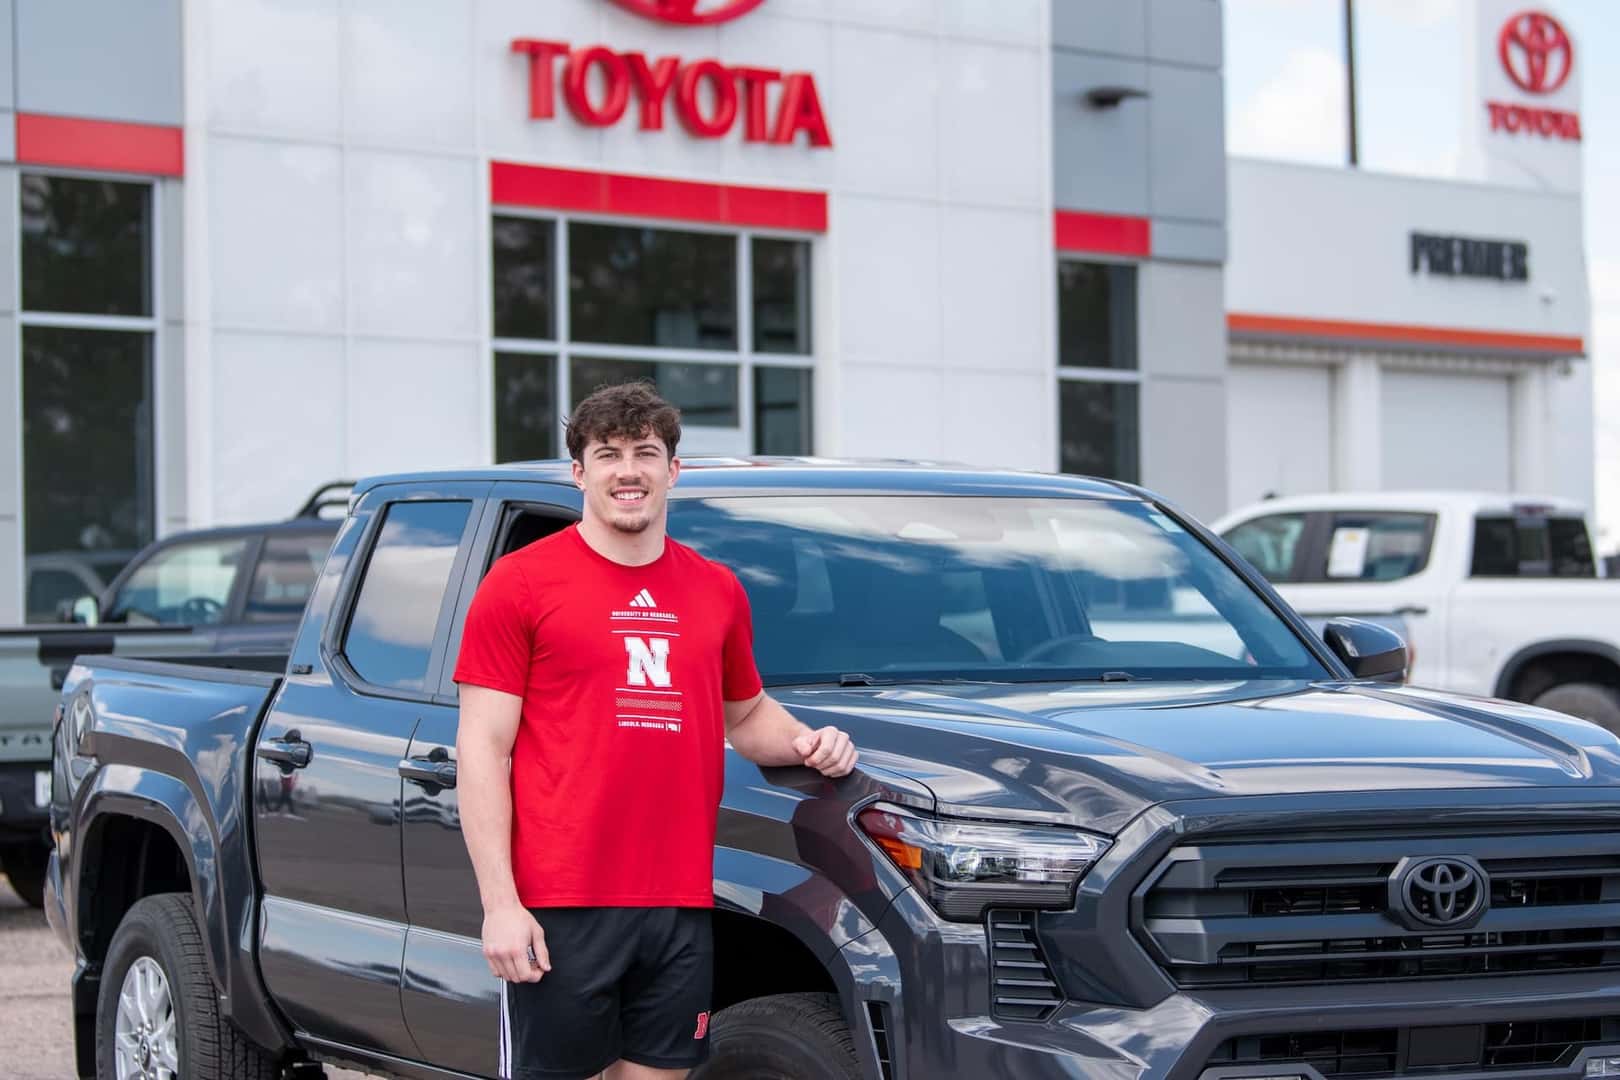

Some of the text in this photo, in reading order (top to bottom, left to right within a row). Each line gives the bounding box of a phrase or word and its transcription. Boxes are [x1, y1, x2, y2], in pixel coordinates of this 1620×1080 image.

[511, 38, 832, 147] TOYOTA
[1486, 102, 1582, 142] TOYOTA
[1411, 233, 1528, 281] PREMIER
[624, 637, 672, 687] N
